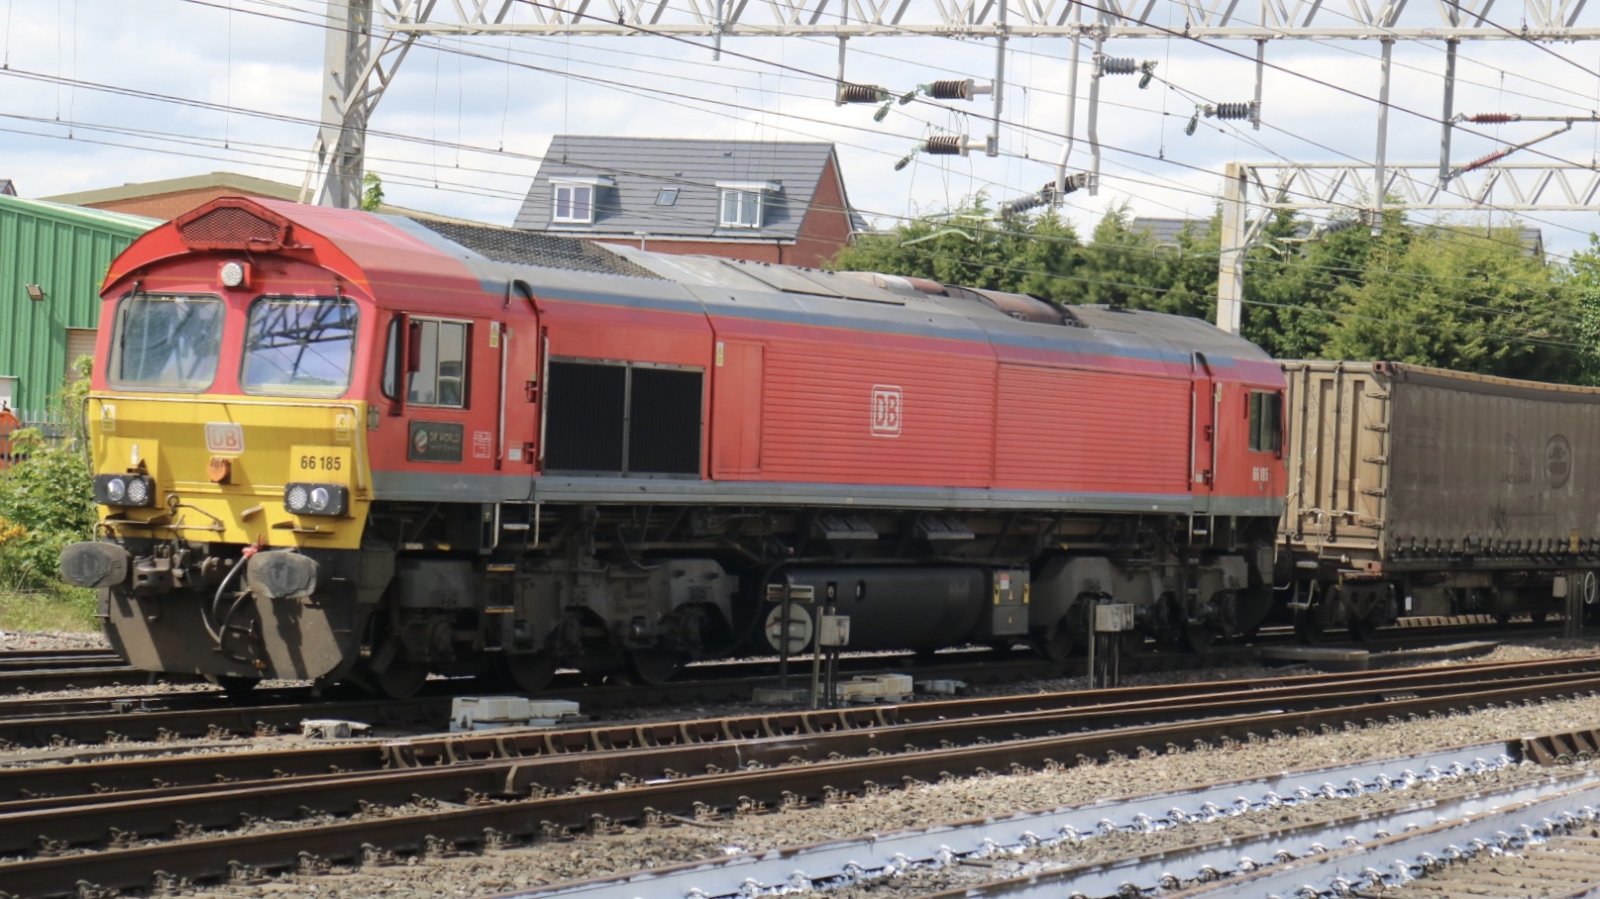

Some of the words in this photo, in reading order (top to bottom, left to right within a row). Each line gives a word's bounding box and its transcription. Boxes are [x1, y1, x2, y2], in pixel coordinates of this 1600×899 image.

[874, 390, 899, 430] DB
[301, 456, 316, 470] 66
[319, 456, 341, 471] 185
